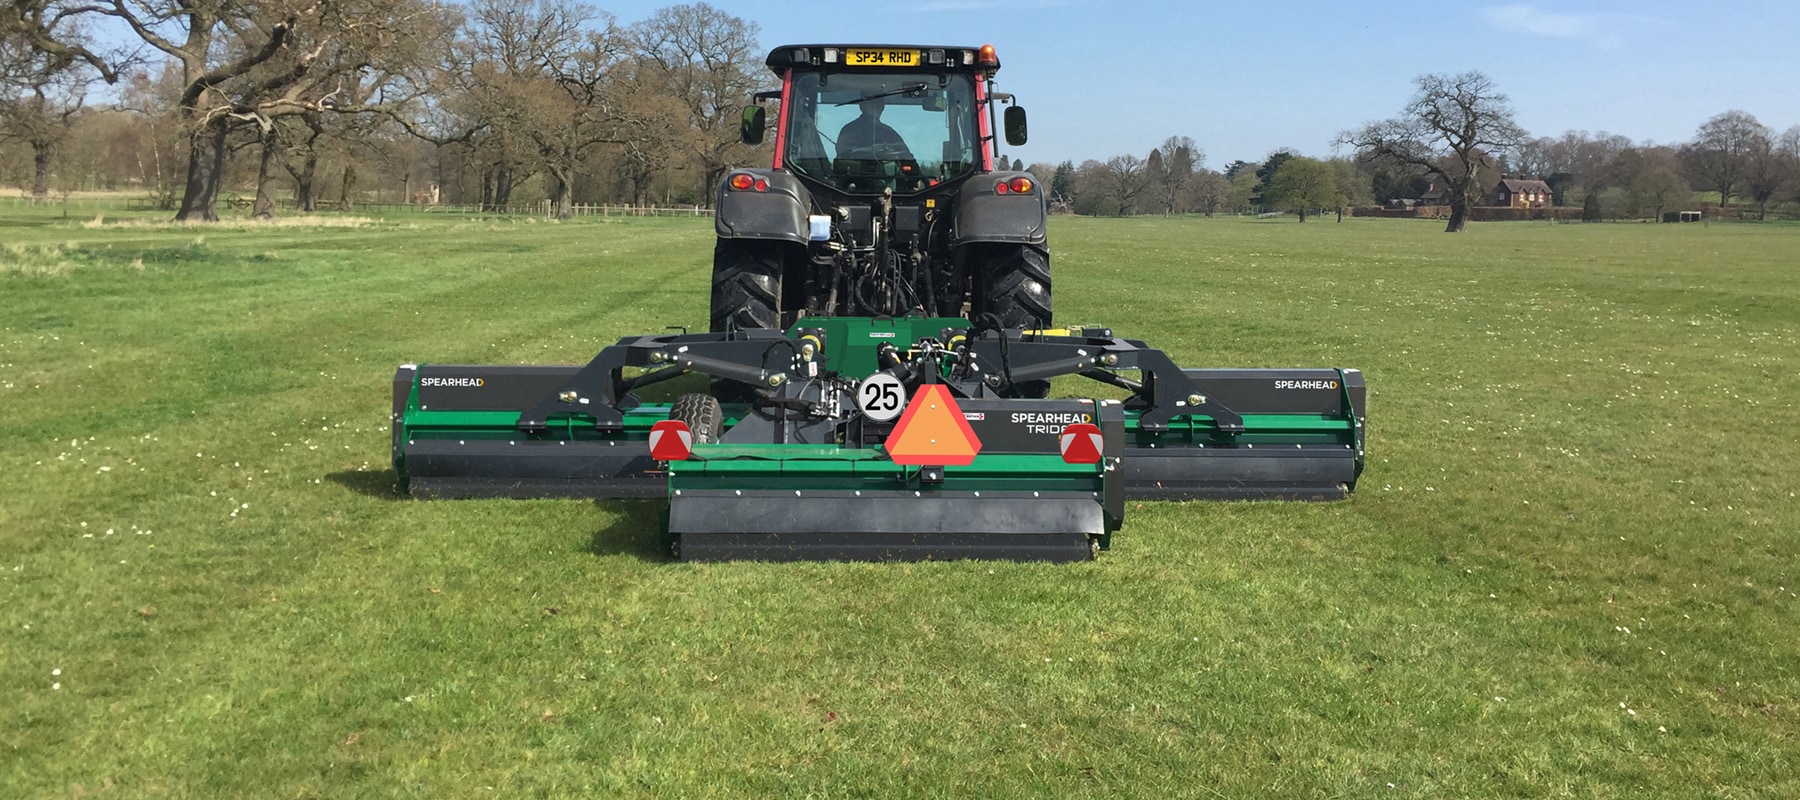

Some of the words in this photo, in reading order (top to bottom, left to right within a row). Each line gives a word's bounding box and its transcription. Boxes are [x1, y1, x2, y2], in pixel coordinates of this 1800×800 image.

[856, 51, 884, 63] SP34
[889, 51, 911, 63] RHD
[421, 378, 484, 386] SPEARHEAD
[1275, 381, 1337, 389] SPEARHEAD
[865, 383, 899, 411] 25
[1011, 413, 1091, 423] SPEARHEAD
